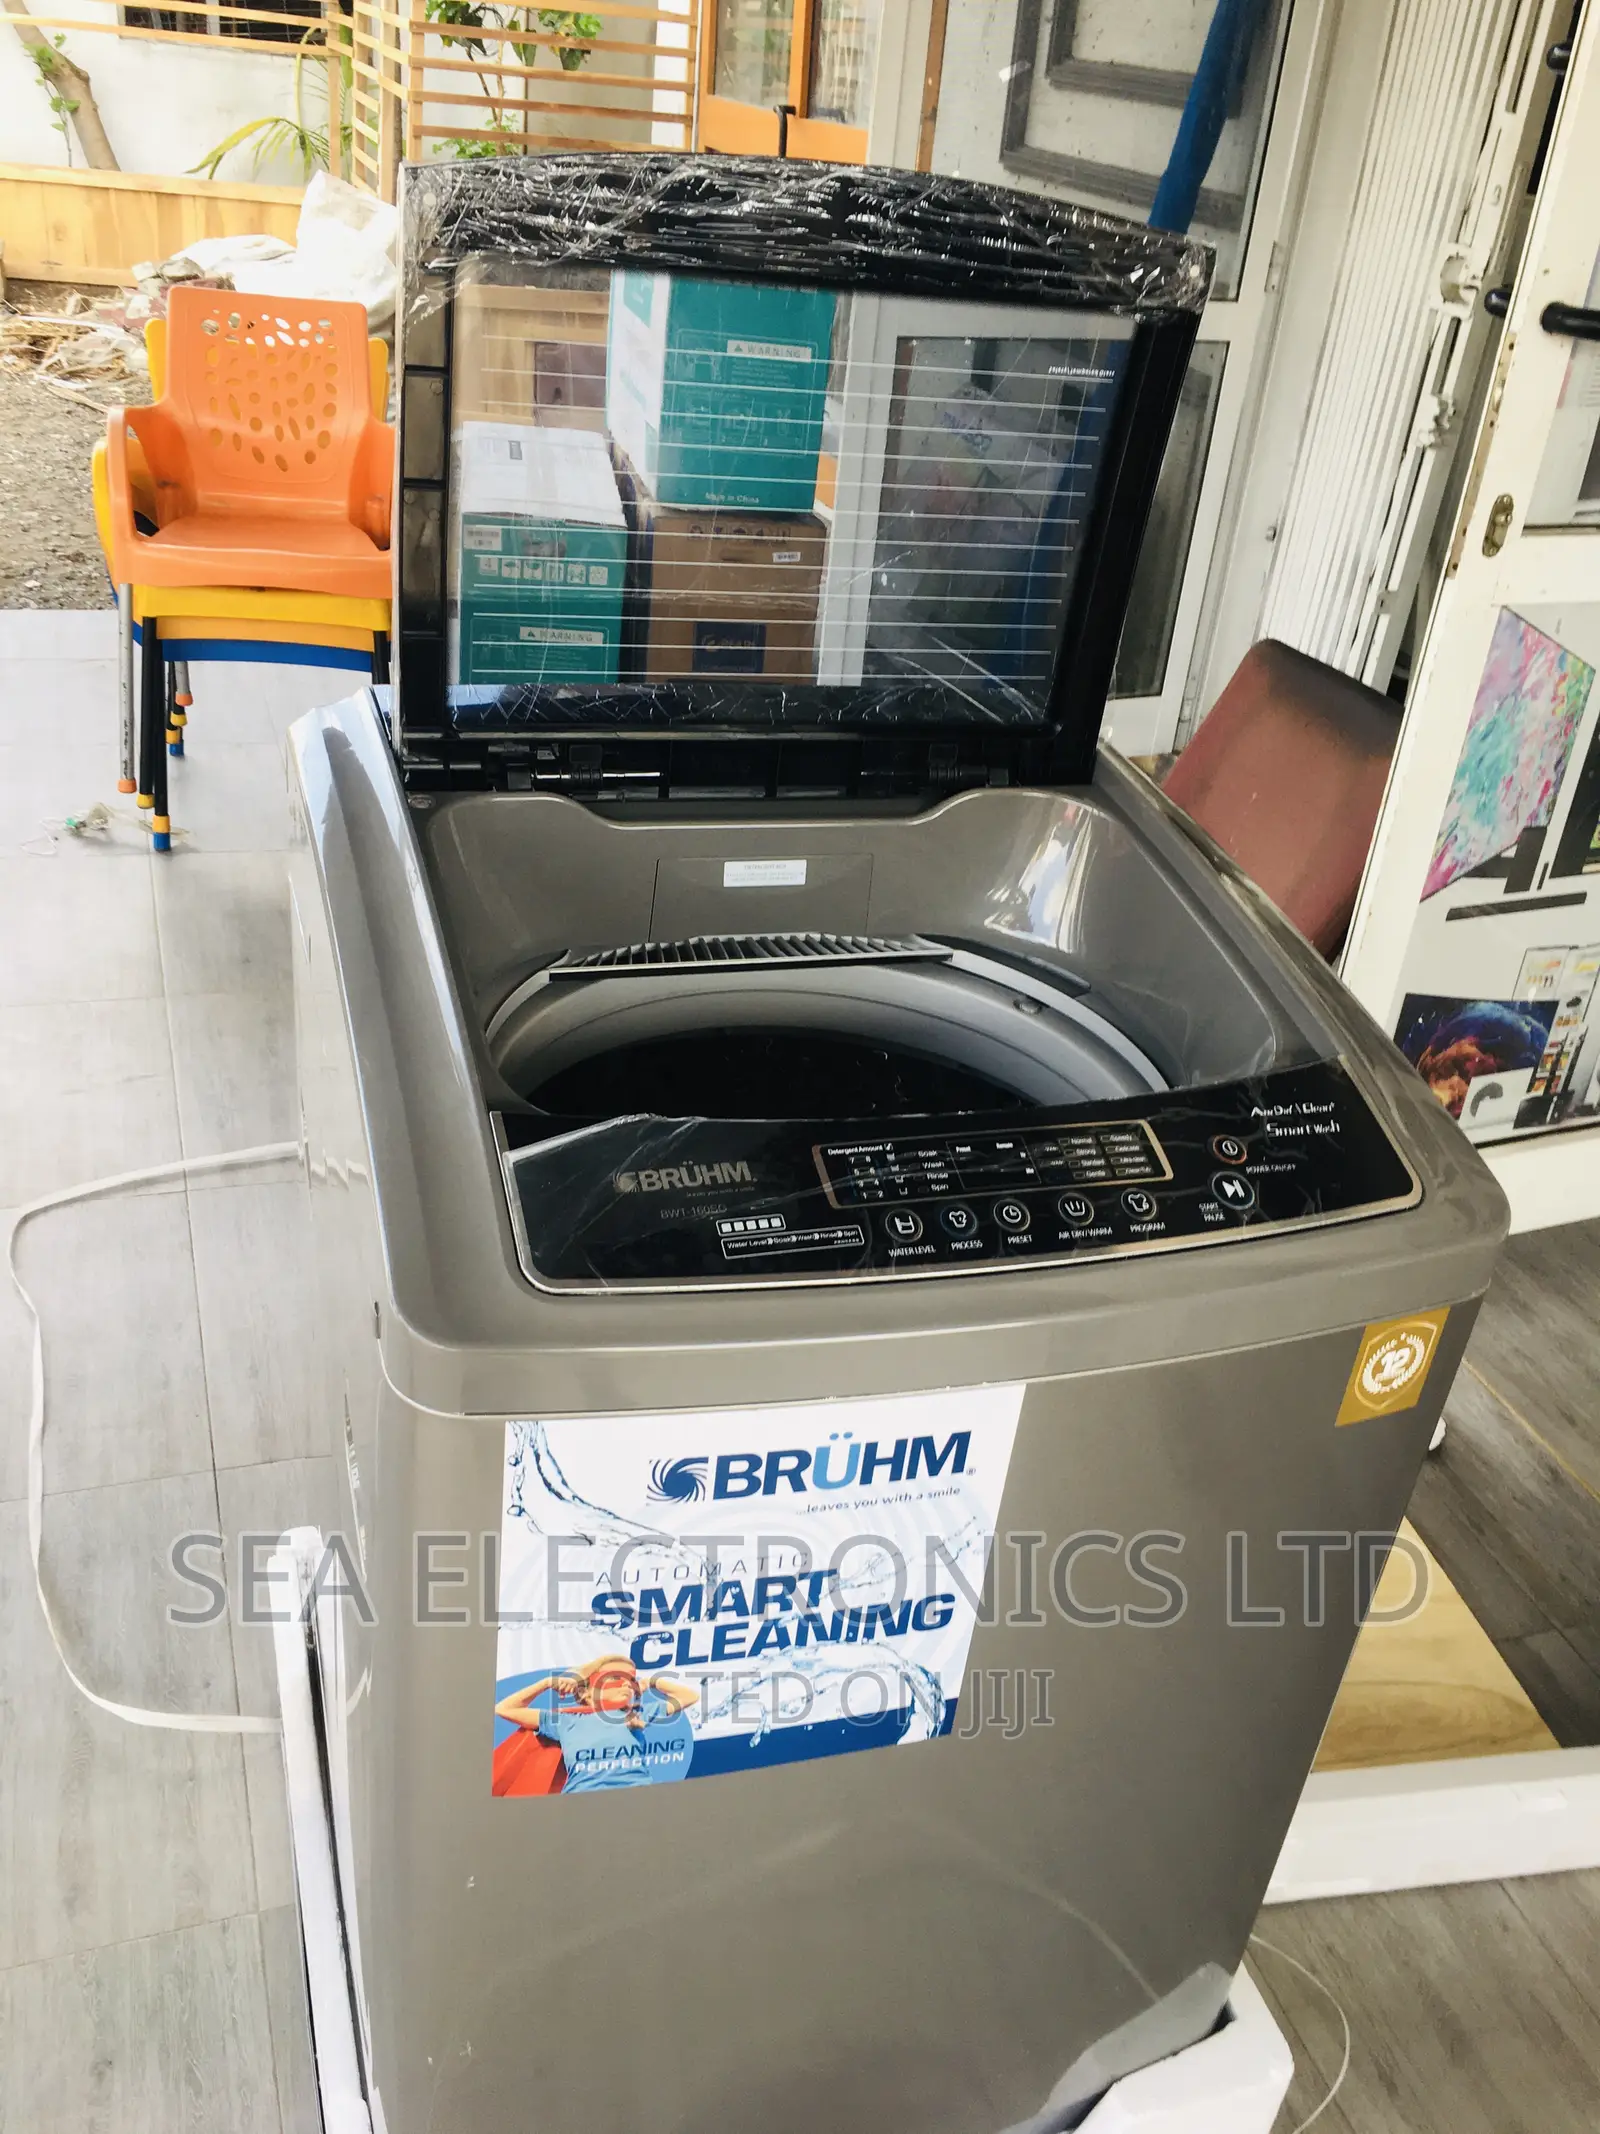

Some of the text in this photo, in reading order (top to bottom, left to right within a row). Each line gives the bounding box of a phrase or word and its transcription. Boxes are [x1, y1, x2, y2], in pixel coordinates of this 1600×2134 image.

[748, 344, 801, 358] WARNING
[638, 1160, 753, 1192] BRÜHM
[888, 1244, 937, 1258] WATER LEVEL
[712, 1431, 973, 1500] BRÜHM
[854, 1498, 879, 1510] you
[882, 1491, 913, 1504] with
[916, 1493, 924, 1501] a
[927, 1486, 961, 1499] smile
[595, 1552, 812, 1586] AUTOMATIC
[590, 1568, 839, 1631] SMART
[629, 1593, 956, 1670] CLEANING
[575, 1738, 686, 1762] CLEANING
[575, 1751, 685, 1774] PERFECTION
